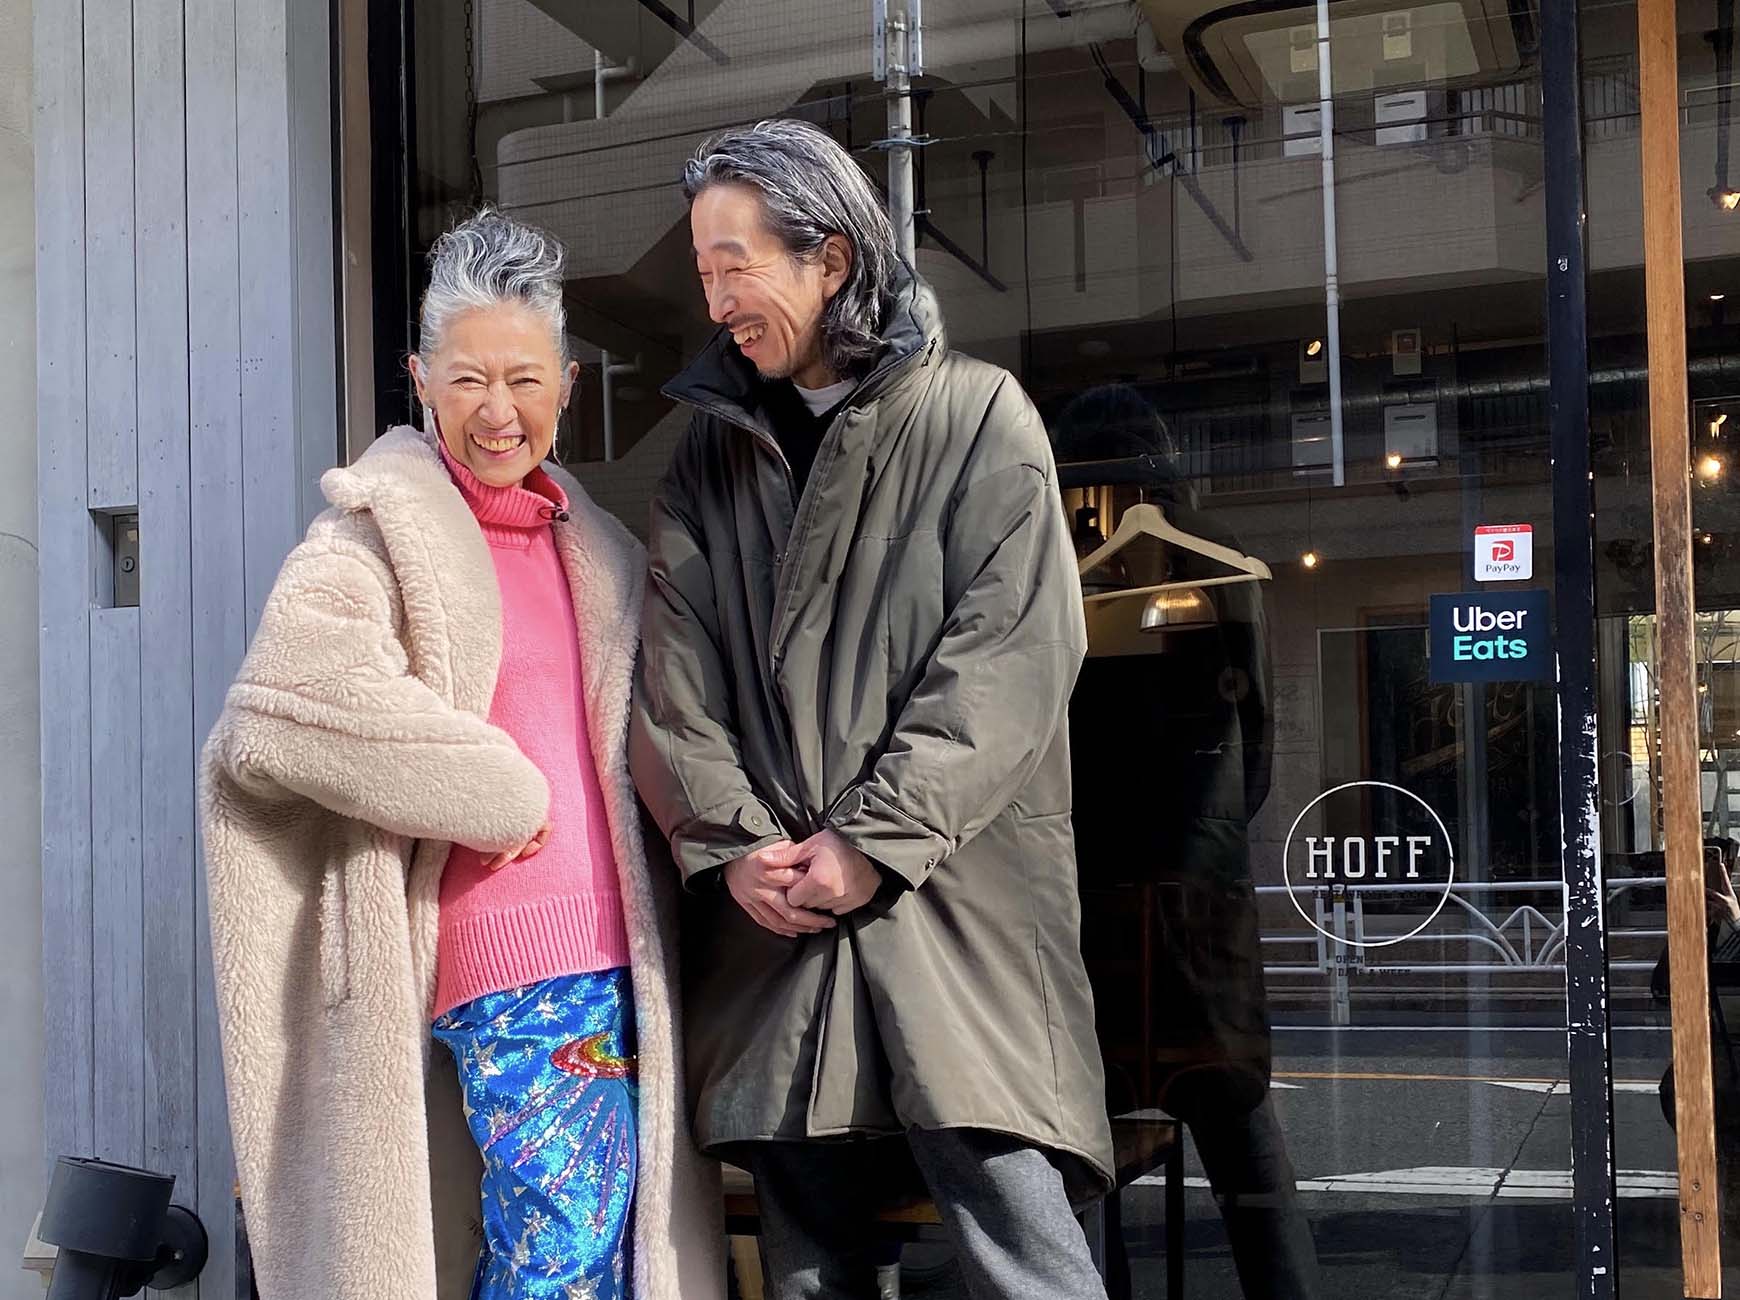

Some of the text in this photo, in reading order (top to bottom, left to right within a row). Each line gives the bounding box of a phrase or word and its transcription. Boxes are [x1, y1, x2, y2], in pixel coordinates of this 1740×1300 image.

[1486, 563, 1521, 574] PayPay
[1453, 606, 1528, 632] Uber
[1453, 635, 1528, 661] Eats
[1305, 836, 1431, 878] HOFF
[1335, 955, 1364, 964] OPEN
